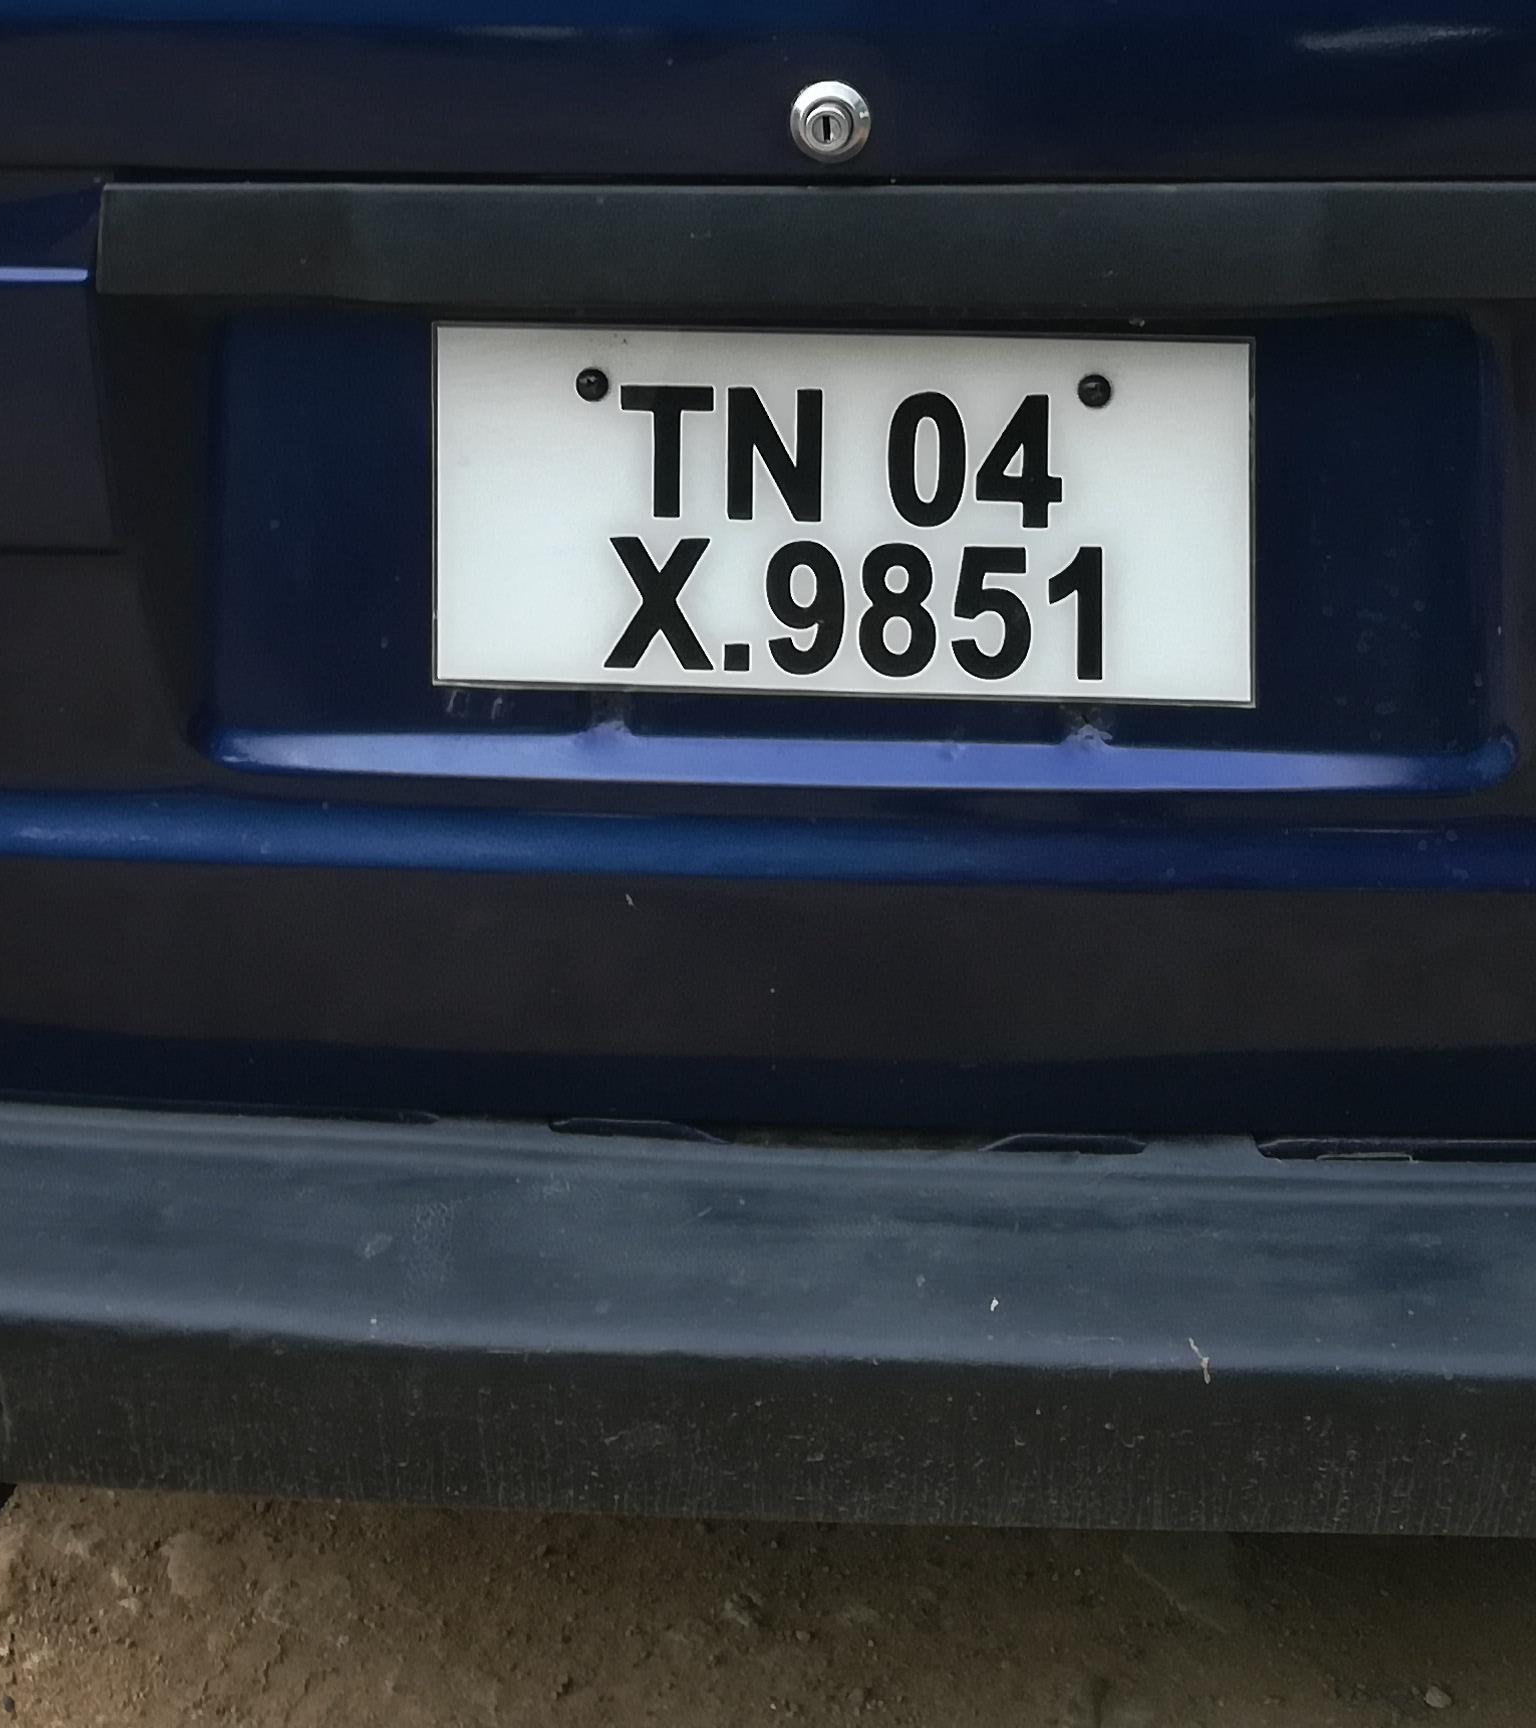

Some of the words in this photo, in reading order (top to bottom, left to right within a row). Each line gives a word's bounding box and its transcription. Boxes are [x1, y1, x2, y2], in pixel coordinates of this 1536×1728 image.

[621, 384, 823, 523] TN
[887, 391, 1064, 530] 04
[603, 535, 1104, 679] X.9851
